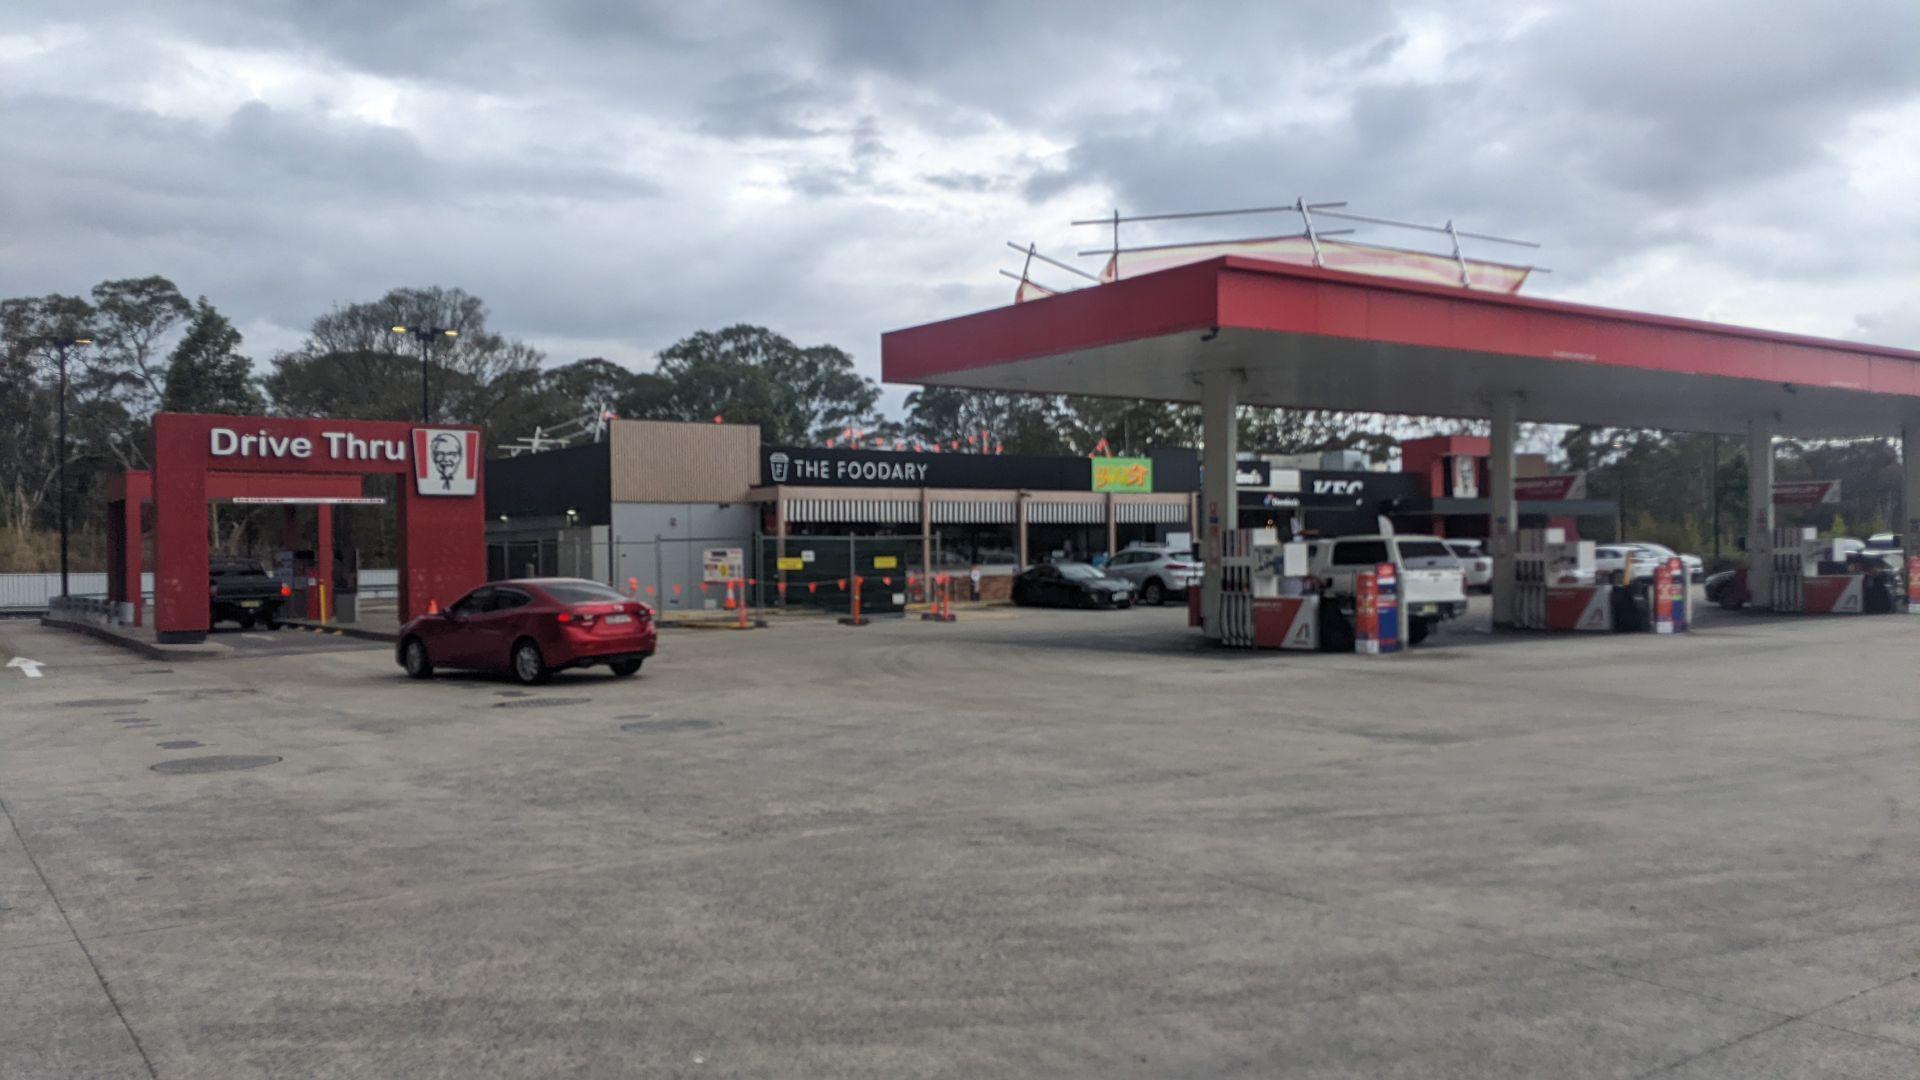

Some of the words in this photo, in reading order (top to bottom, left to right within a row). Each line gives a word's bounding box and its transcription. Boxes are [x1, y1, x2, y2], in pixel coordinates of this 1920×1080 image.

[209, 427, 312, 459] Drive
[321, 431, 407, 461] Thru
[793, 459, 830, 479] THE
[837, 460, 929, 482] FOODARY
